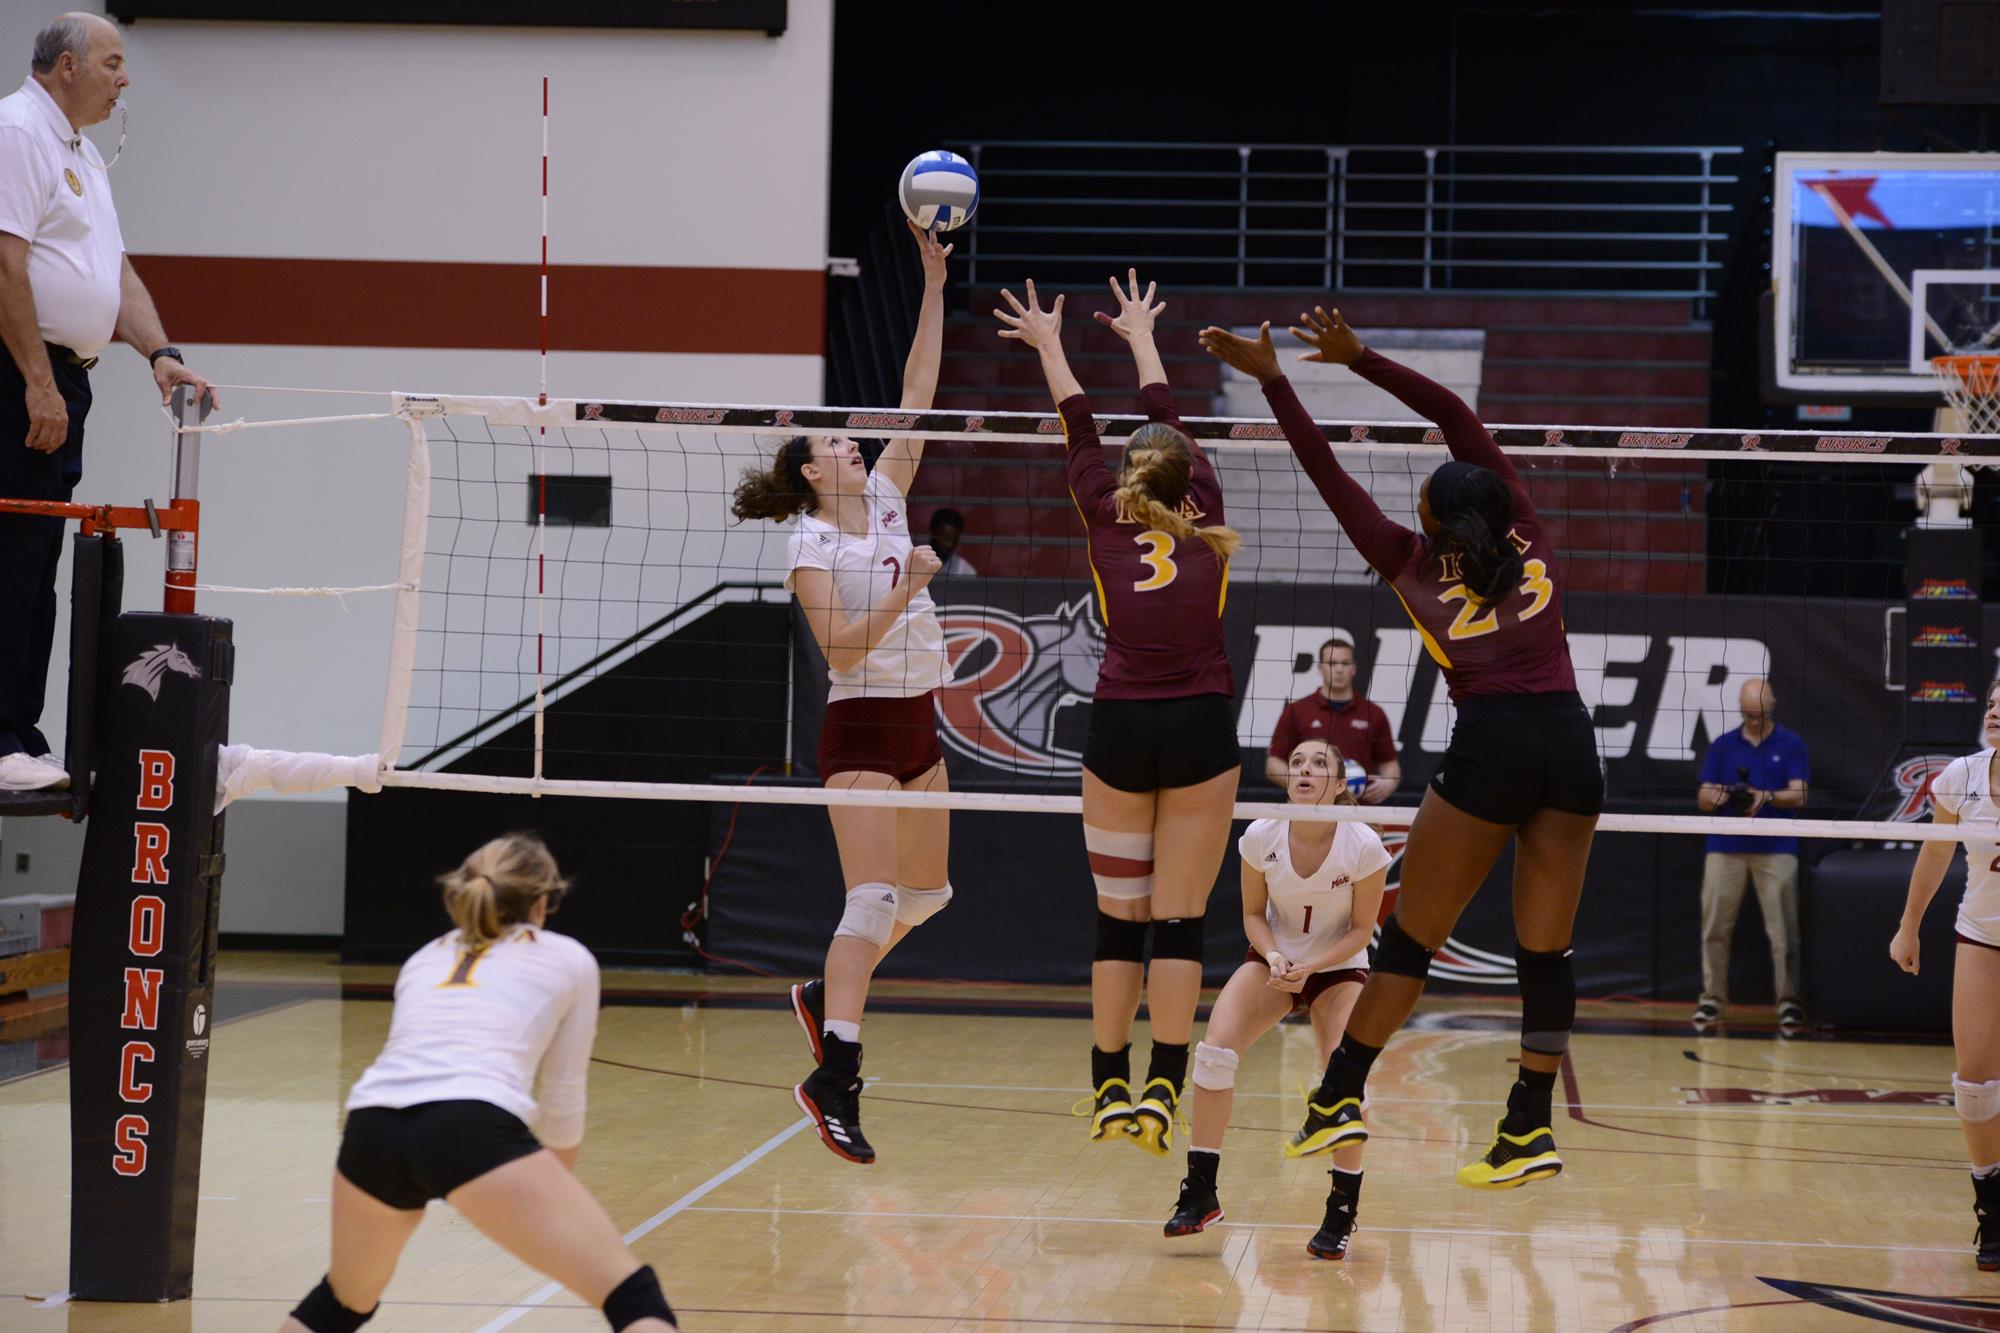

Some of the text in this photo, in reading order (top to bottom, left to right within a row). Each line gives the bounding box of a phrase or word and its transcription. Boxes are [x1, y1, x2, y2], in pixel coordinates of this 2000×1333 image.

[584, 404, 605, 421] R
[655, 407, 729, 425] BRONCS
[774, 410, 797, 427] R
[845, 413, 920, 430] BRONCS
[963, 416, 986, 433] R
[1349, 426, 1371, 443] R
[1542, 430, 1566, 447] R
[1618, 432, 1693, 449] BRONCS
[1739, 434, 1763, 451] R
[1815, 436, 1892, 453] BRONCS
[1939, 438, 1963, 456] R
[882, 556, 901, 591] 7
[1133, 530, 1178, 592] 3
[1437, 558, 1554, 641] 23
[1237, 624, 1772, 761] RIER
[1302, 904, 1313, 934] 1
[112, 749, 175, 1177] BRONCS
